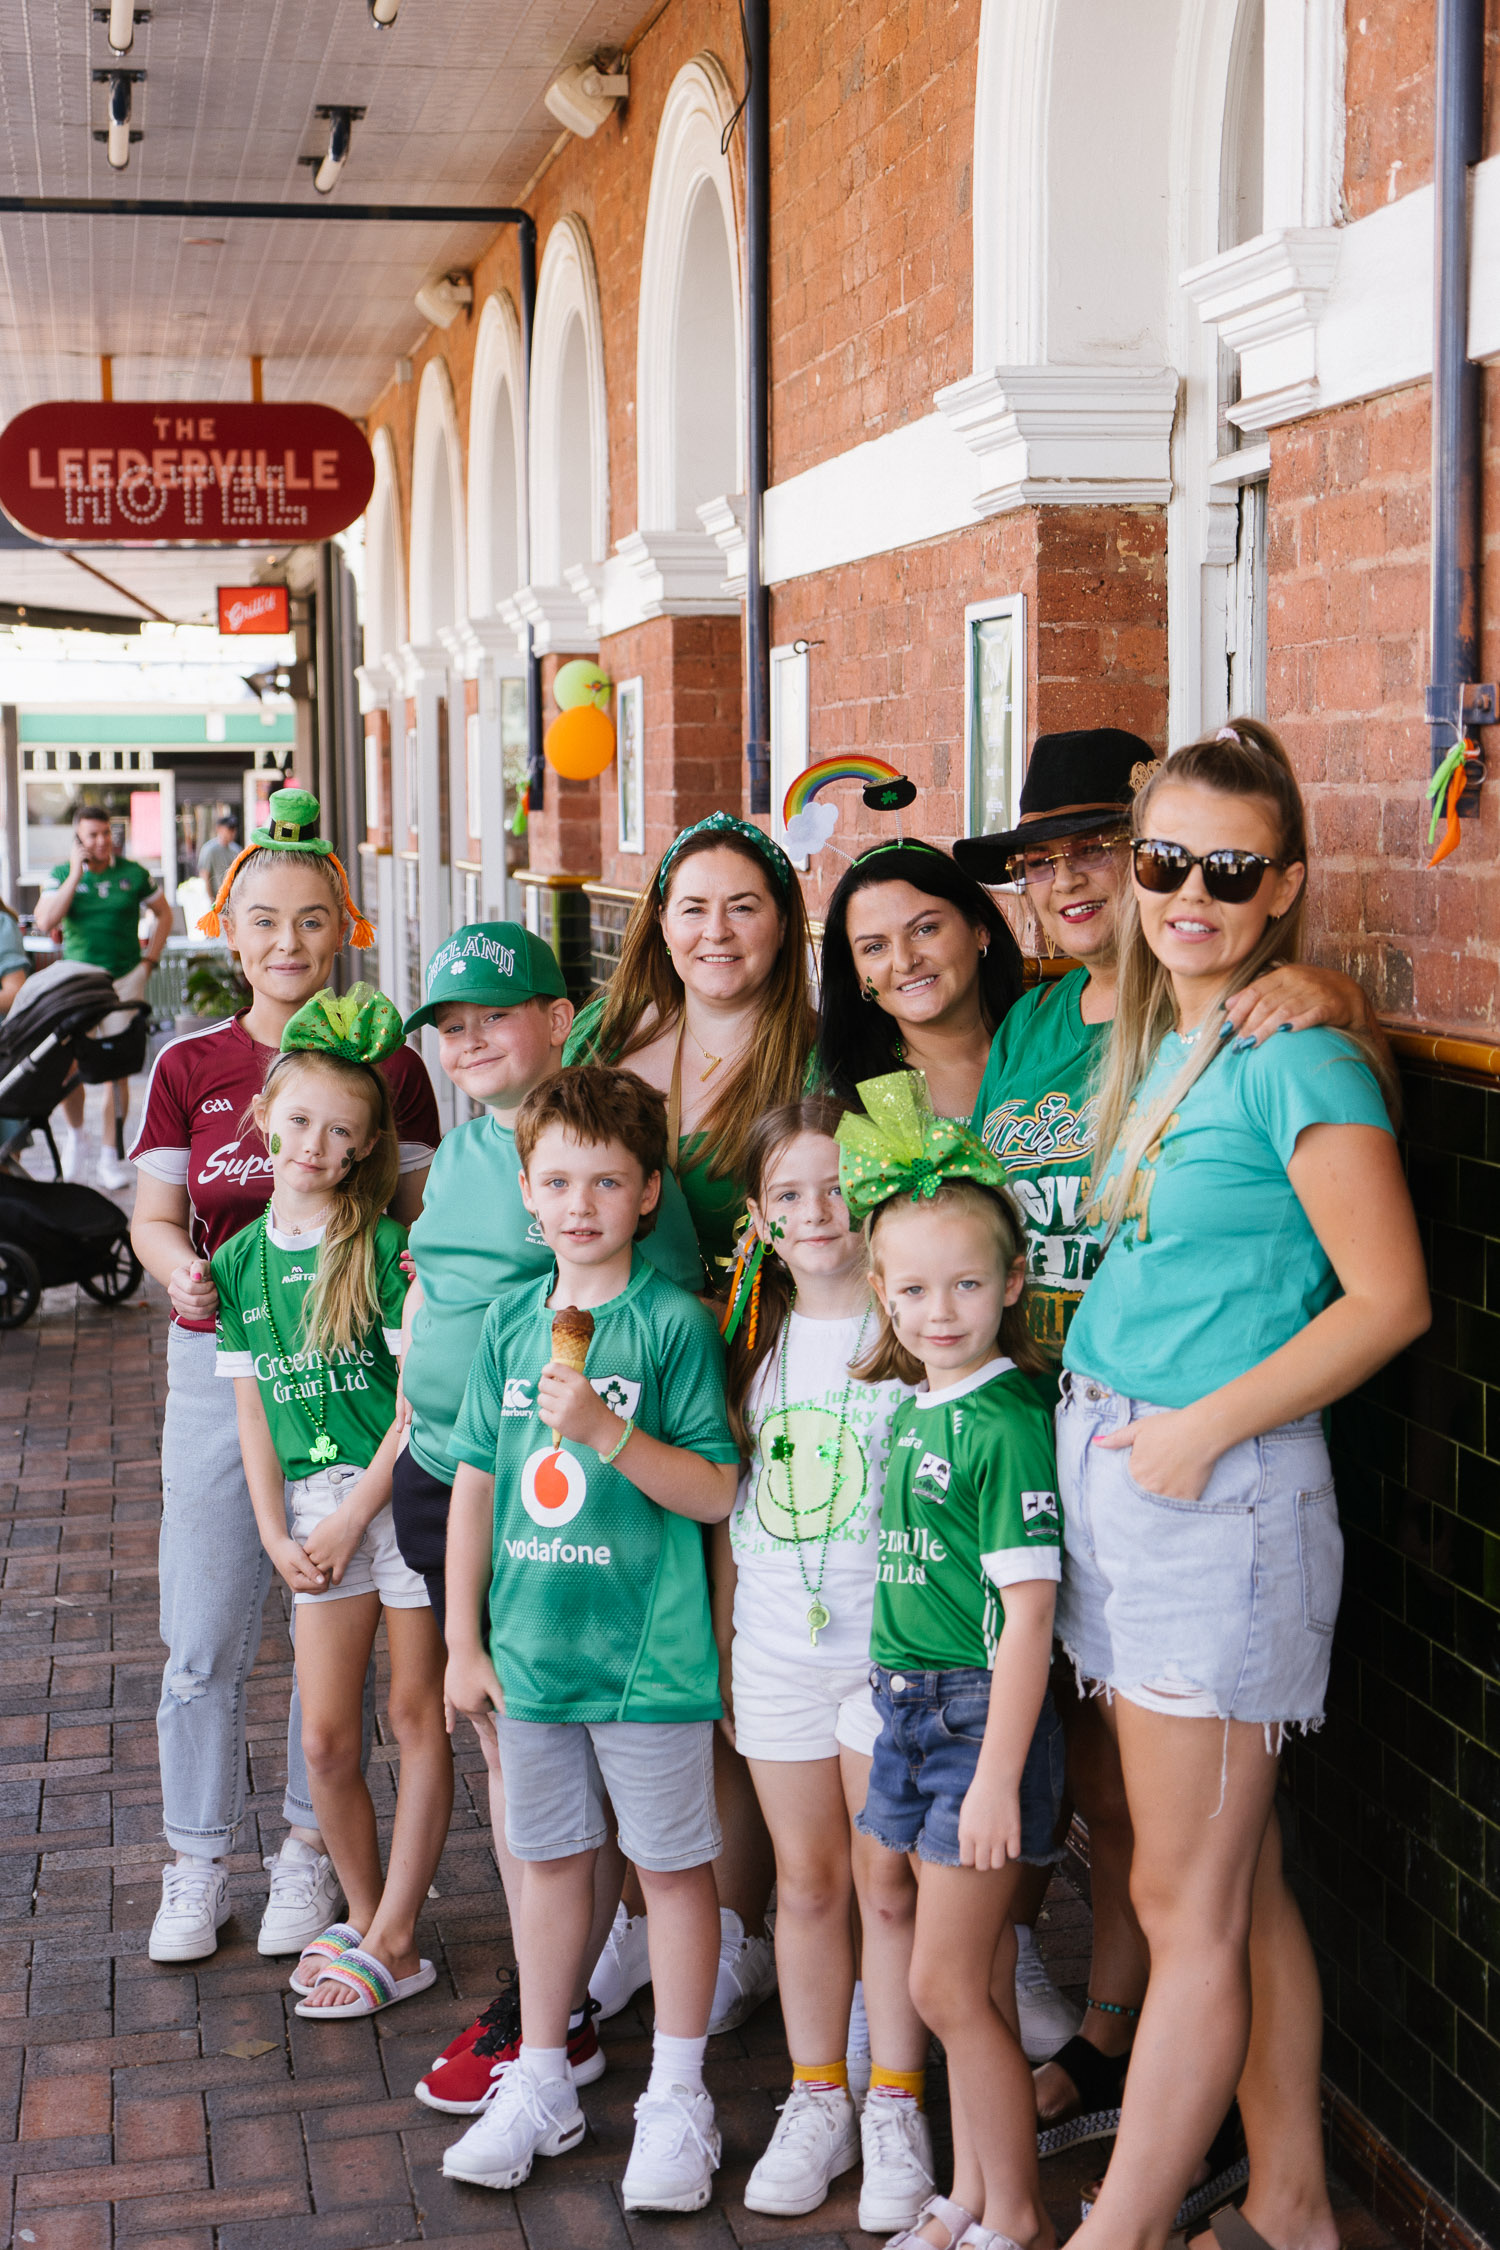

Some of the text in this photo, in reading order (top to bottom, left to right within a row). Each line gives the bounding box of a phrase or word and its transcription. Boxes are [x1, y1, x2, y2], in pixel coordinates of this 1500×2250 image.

[154, 417, 216, 441] THE
[28, 449, 340, 490] LEEDERVILLE
[65, 464, 307, 525] HOTEL
[427, 935, 514, 1000] IRELAND
[201, 1098, 233, 1114] GAA
[981, 1096, 1101, 1158] Irish
[198, 1141, 275, 1186] Supe
[273, 1368, 369, 1404] Grain Ltd
[504, 1536, 611, 1565] vodafone
